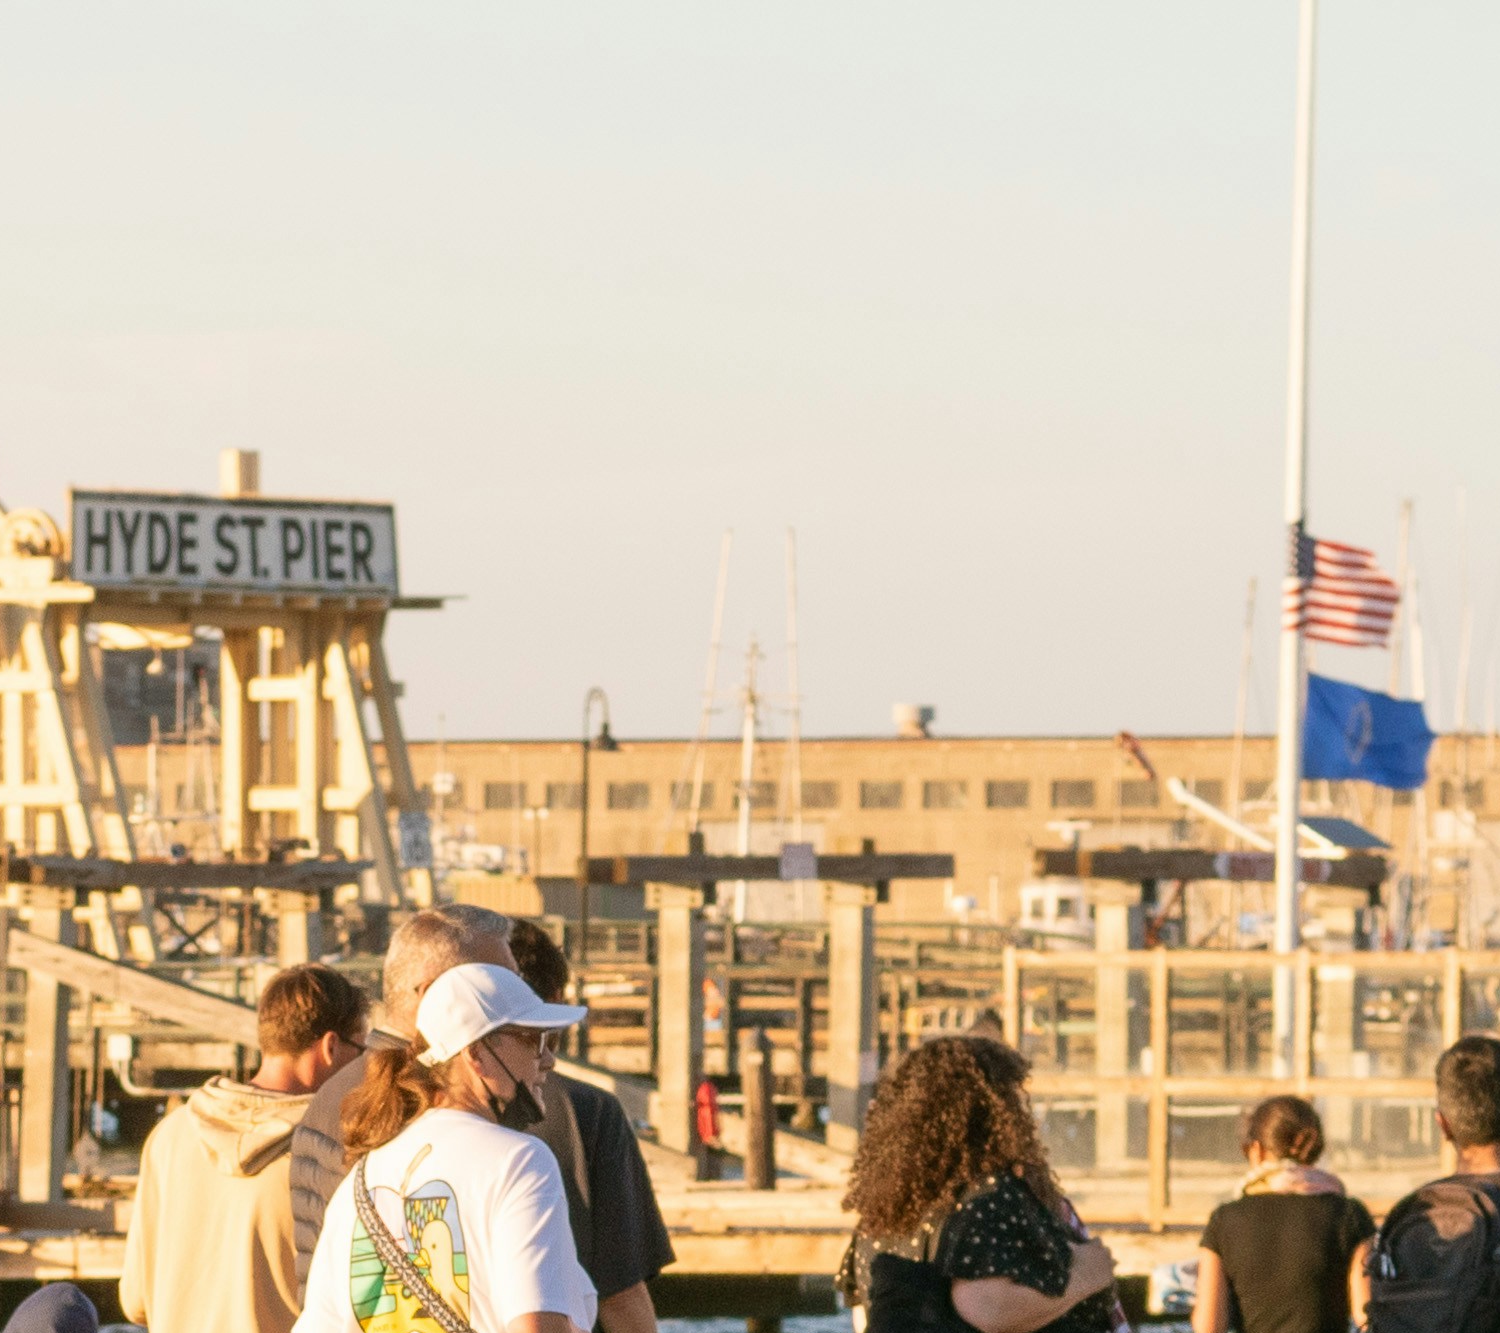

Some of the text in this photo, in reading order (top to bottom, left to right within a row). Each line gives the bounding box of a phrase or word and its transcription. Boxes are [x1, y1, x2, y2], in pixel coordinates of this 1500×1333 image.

[84, 508, 375, 582] HYDE ST. PIER
